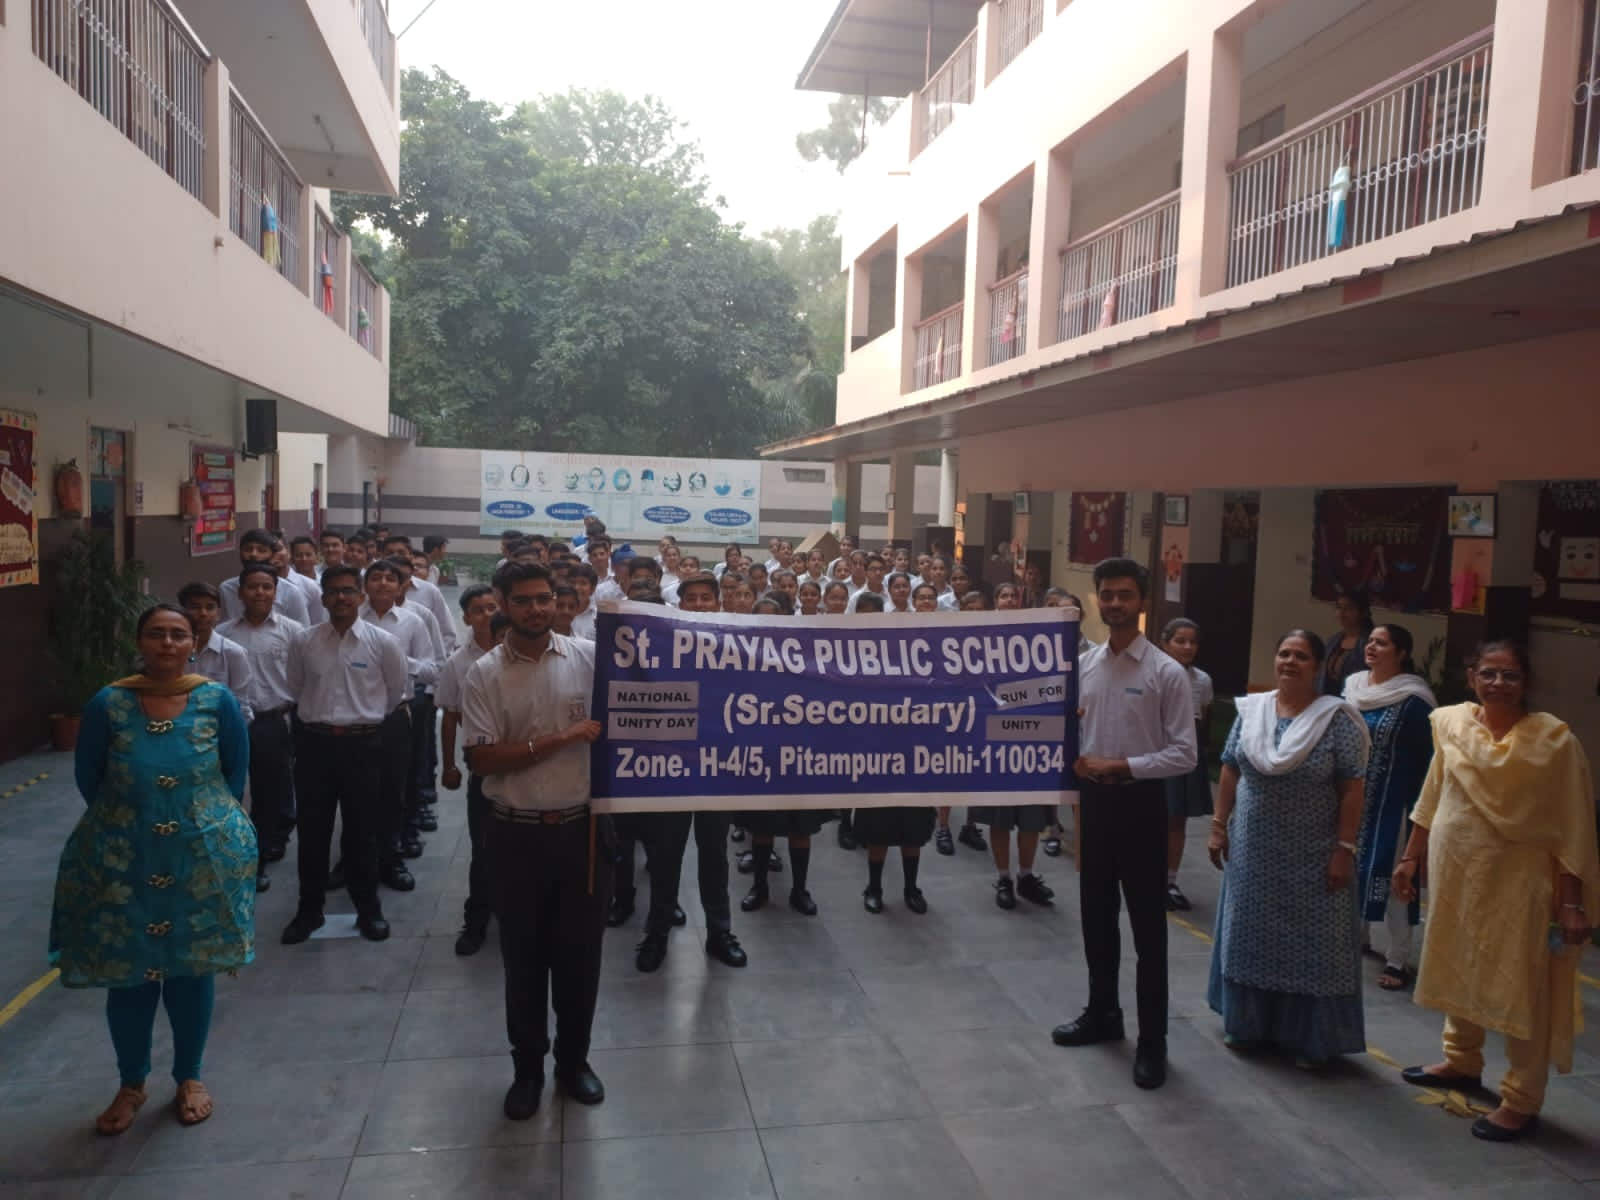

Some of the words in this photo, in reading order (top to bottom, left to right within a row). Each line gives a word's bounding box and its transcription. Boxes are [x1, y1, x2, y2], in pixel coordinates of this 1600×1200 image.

[613, 626, 660, 668] St.
[672, 629, 806, 674] PRAYAG
[814, 638, 933, 676] PUBLIC
[941, 633, 1072, 675] SCHOOL
[617, 692, 692, 703] NATIONAL
[1001, 691, 1028, 703] RUN
[1039, 686, 1063, 697] FOR
[723, 693, 976, 734] (Sr.Secondary)
[617, 718, 663, 729] UNITY
[667, 718, 696, 728] DAY
[1002, 720, 1041, 730] UNITY
[615, 747, 691, 778] Zone.
[700, 746, 771, 783] H-4/5,
[780, 745, 906, 783] Pitampura
[914, 744, 1065, 775] Delhi-110034
